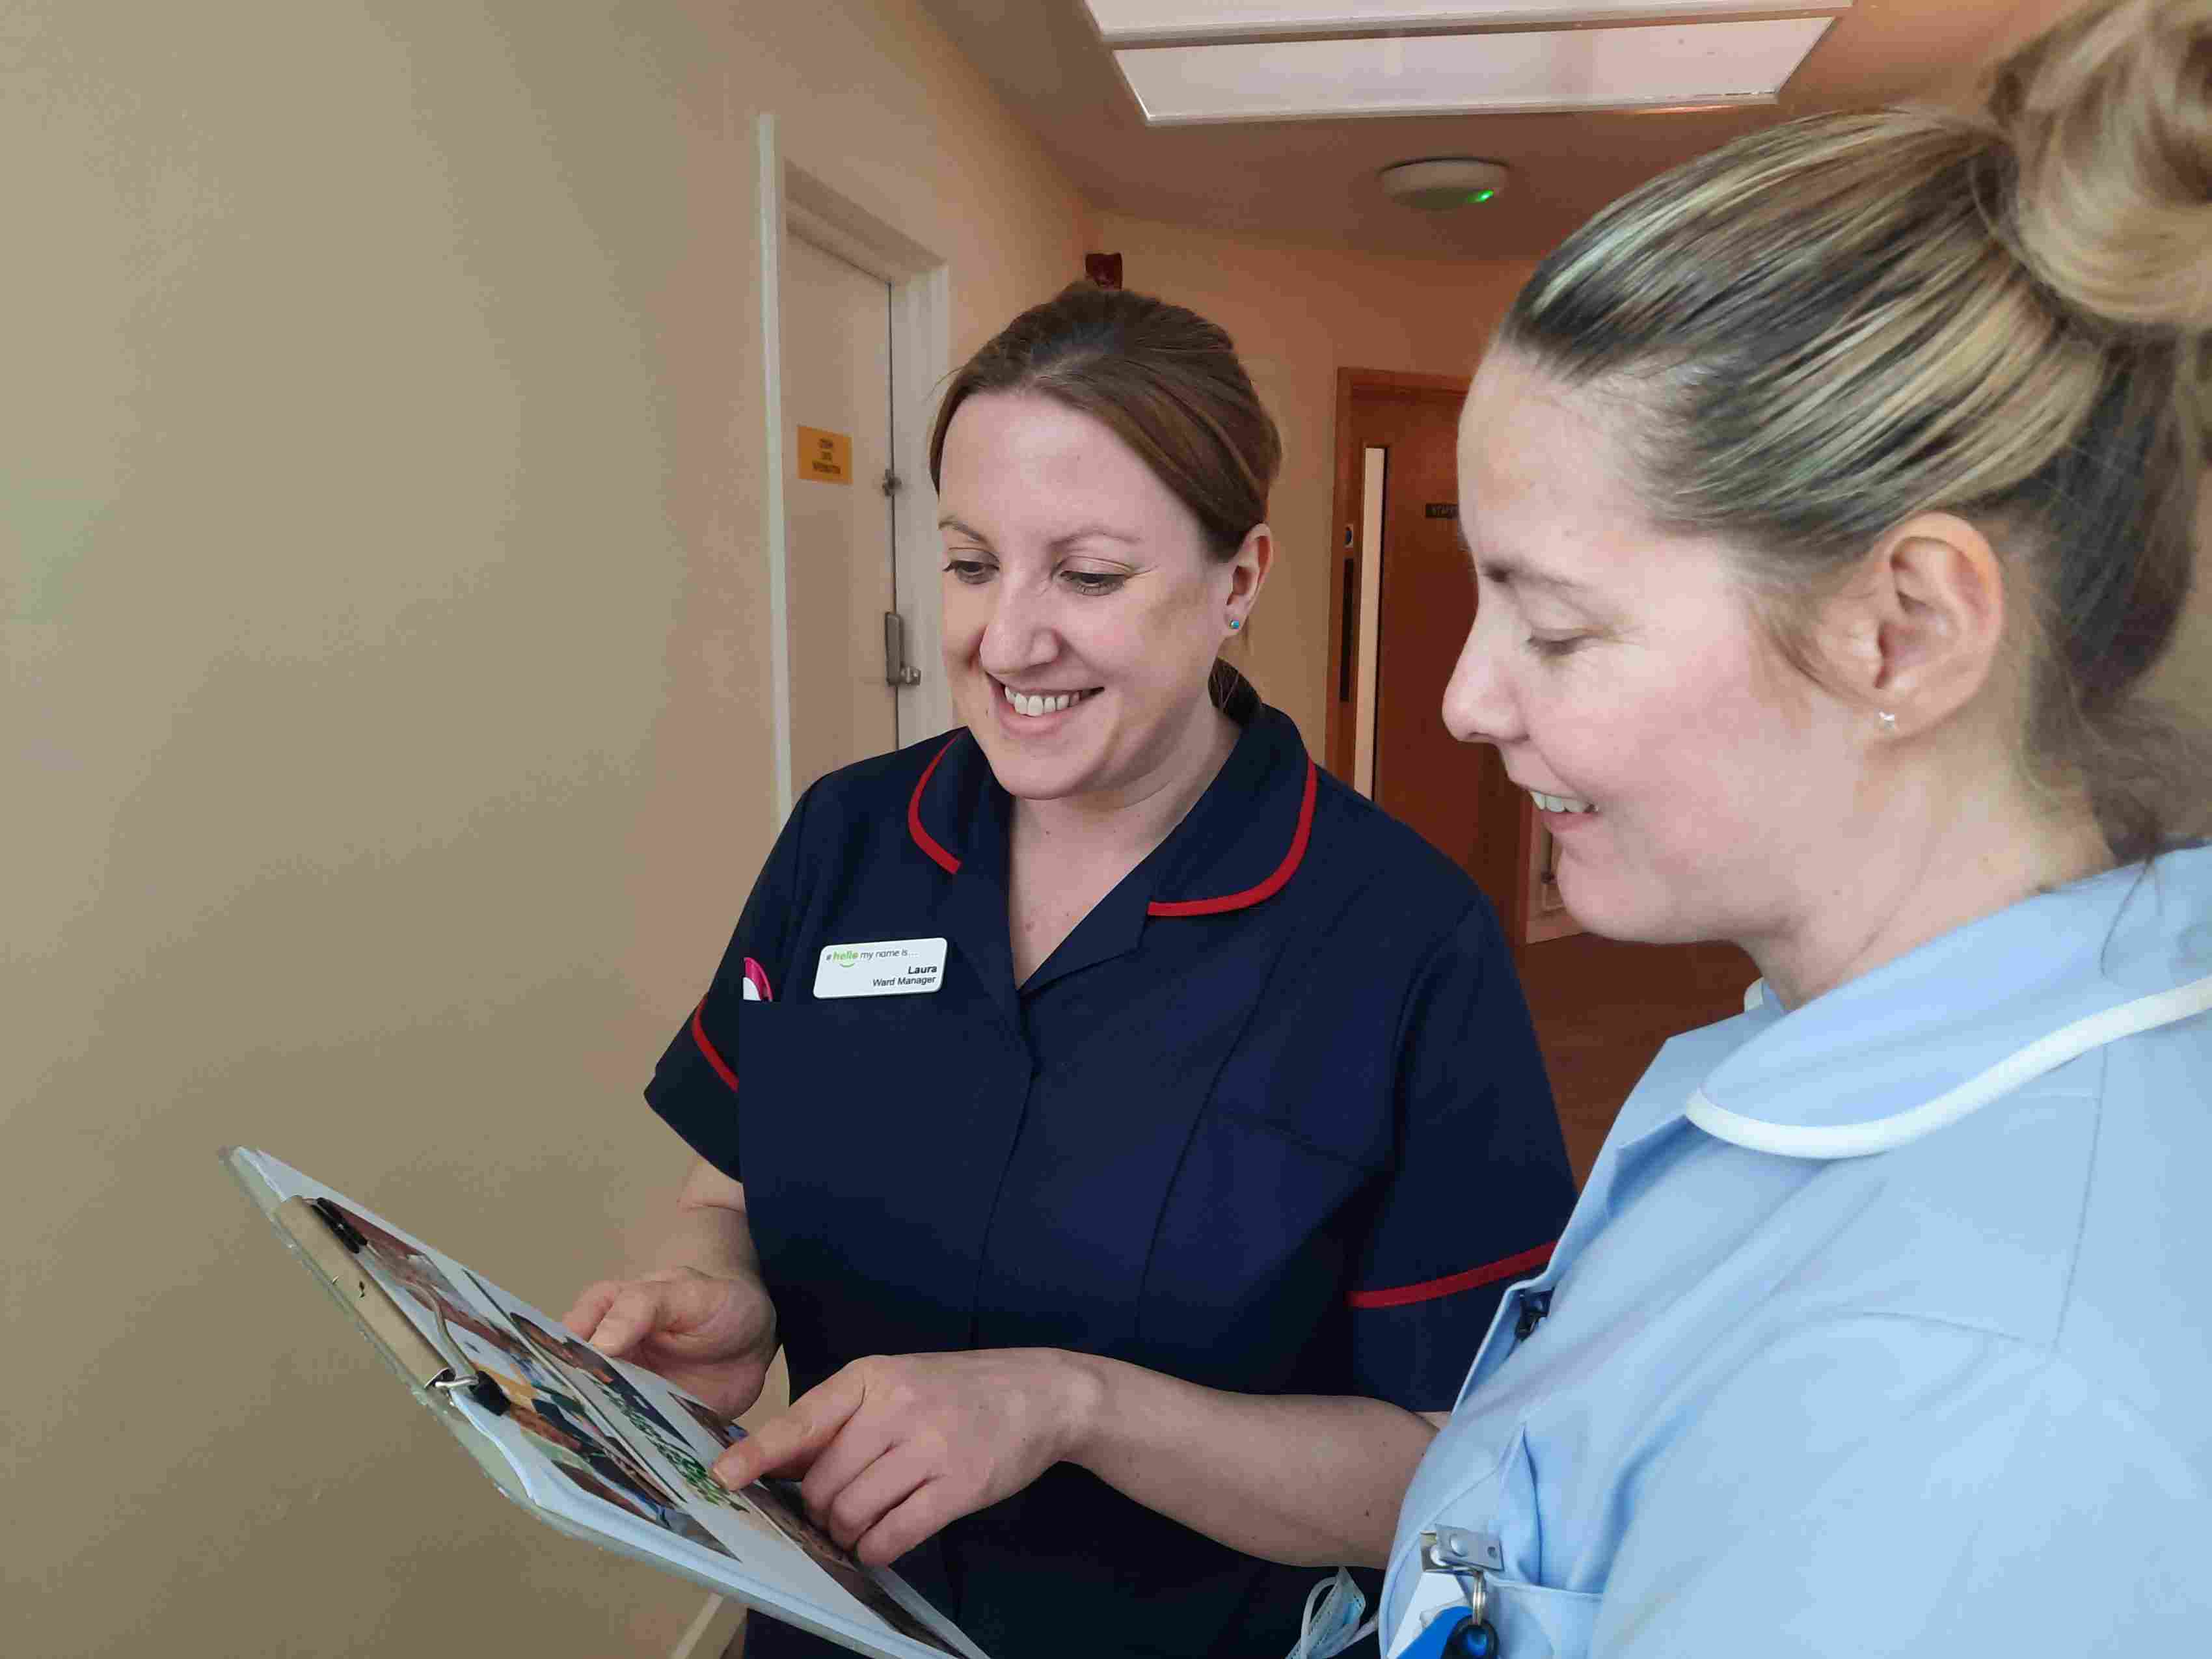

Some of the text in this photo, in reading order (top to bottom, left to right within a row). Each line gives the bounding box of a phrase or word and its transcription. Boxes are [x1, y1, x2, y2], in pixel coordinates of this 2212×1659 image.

[861, 951, 874, 960] my
[876, 950, 900, 958] name
[908, 965, 938, 975] Laura
[872, 976, 937, 987] Ward Manager
